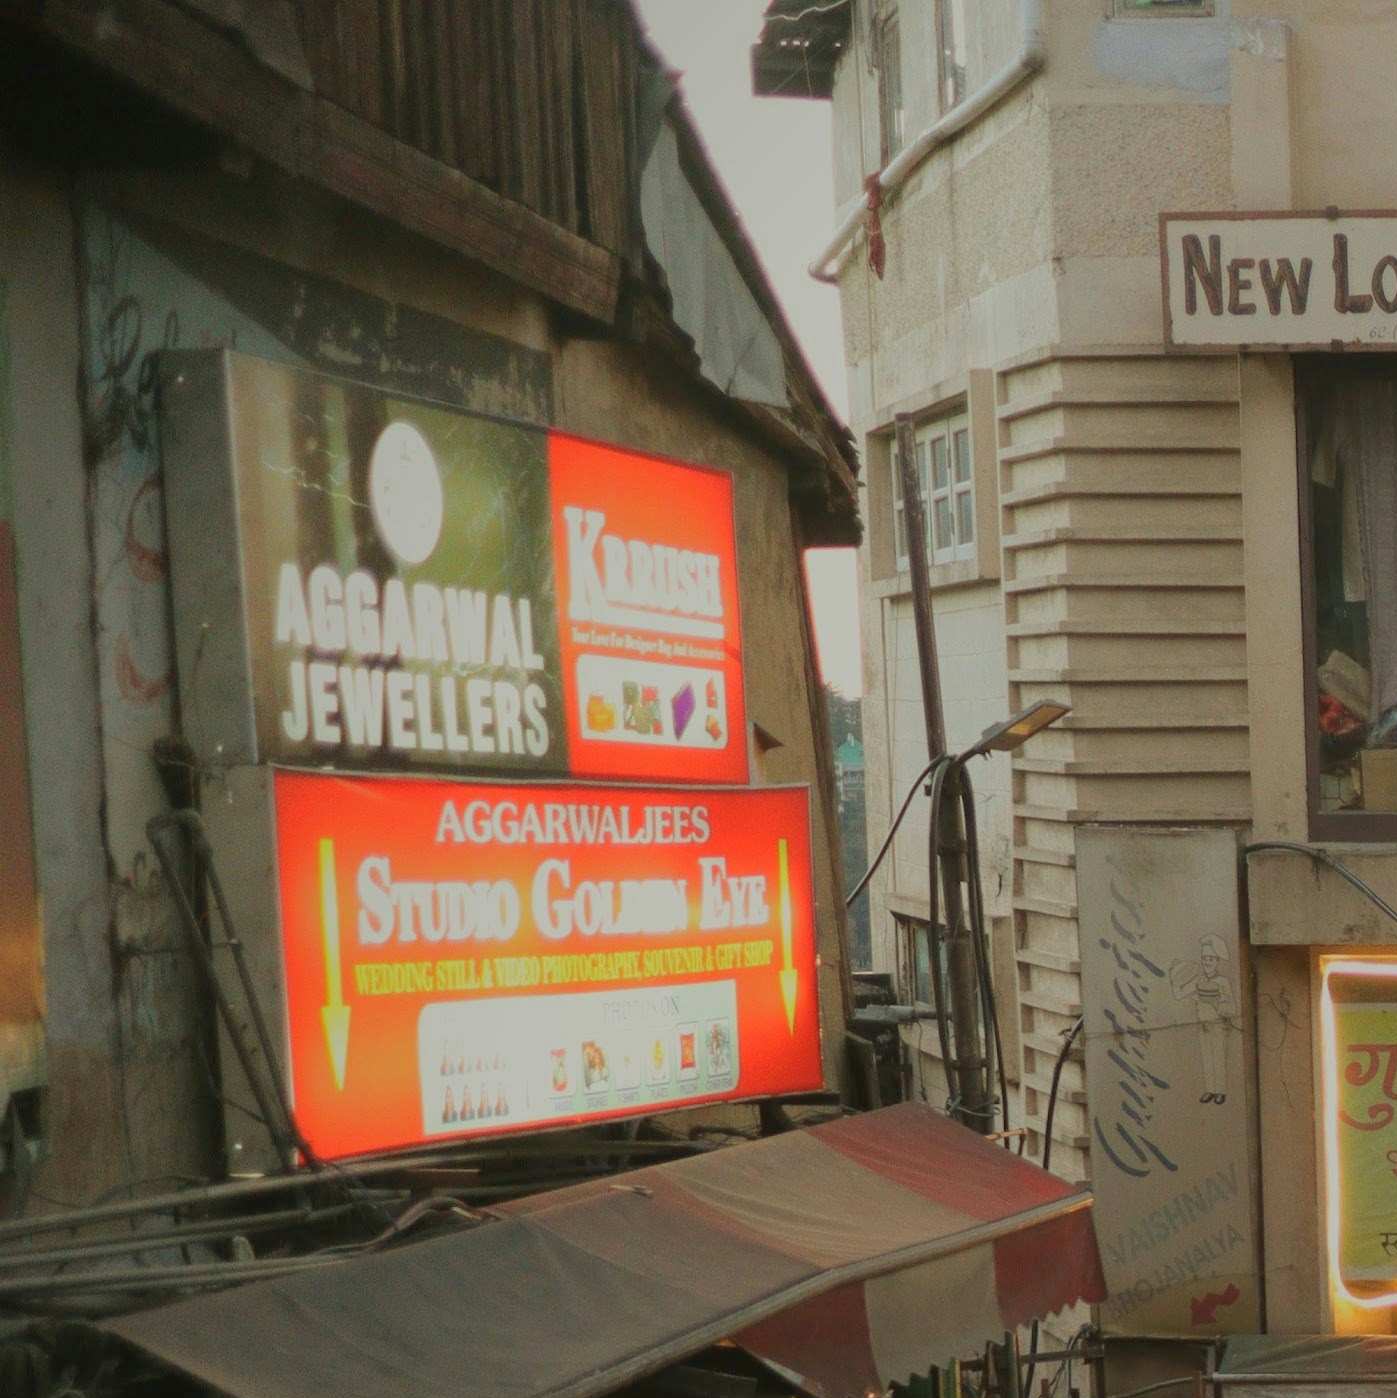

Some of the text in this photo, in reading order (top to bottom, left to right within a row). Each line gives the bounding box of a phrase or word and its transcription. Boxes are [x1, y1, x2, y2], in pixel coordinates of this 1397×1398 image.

[1181, 232, 1312, 317] NEW
[563, 506, 724, 621] KRRUSH
[276, 560, 545, 671] AGGARWAL
[281, 660, 550, 758] JEWELLERS
[435, 800, 711, 846] AGGARWALJEES
[355, 855, 522, 945] STUDIO
[696, 855, 771, 932] EYE
[354, 960, 434, 996] WEDDING
[435, 959, 481, 992] STILL
[643, 946, 705, 978] SOUVENIR
[743, 939, 774, 968] SHOP
